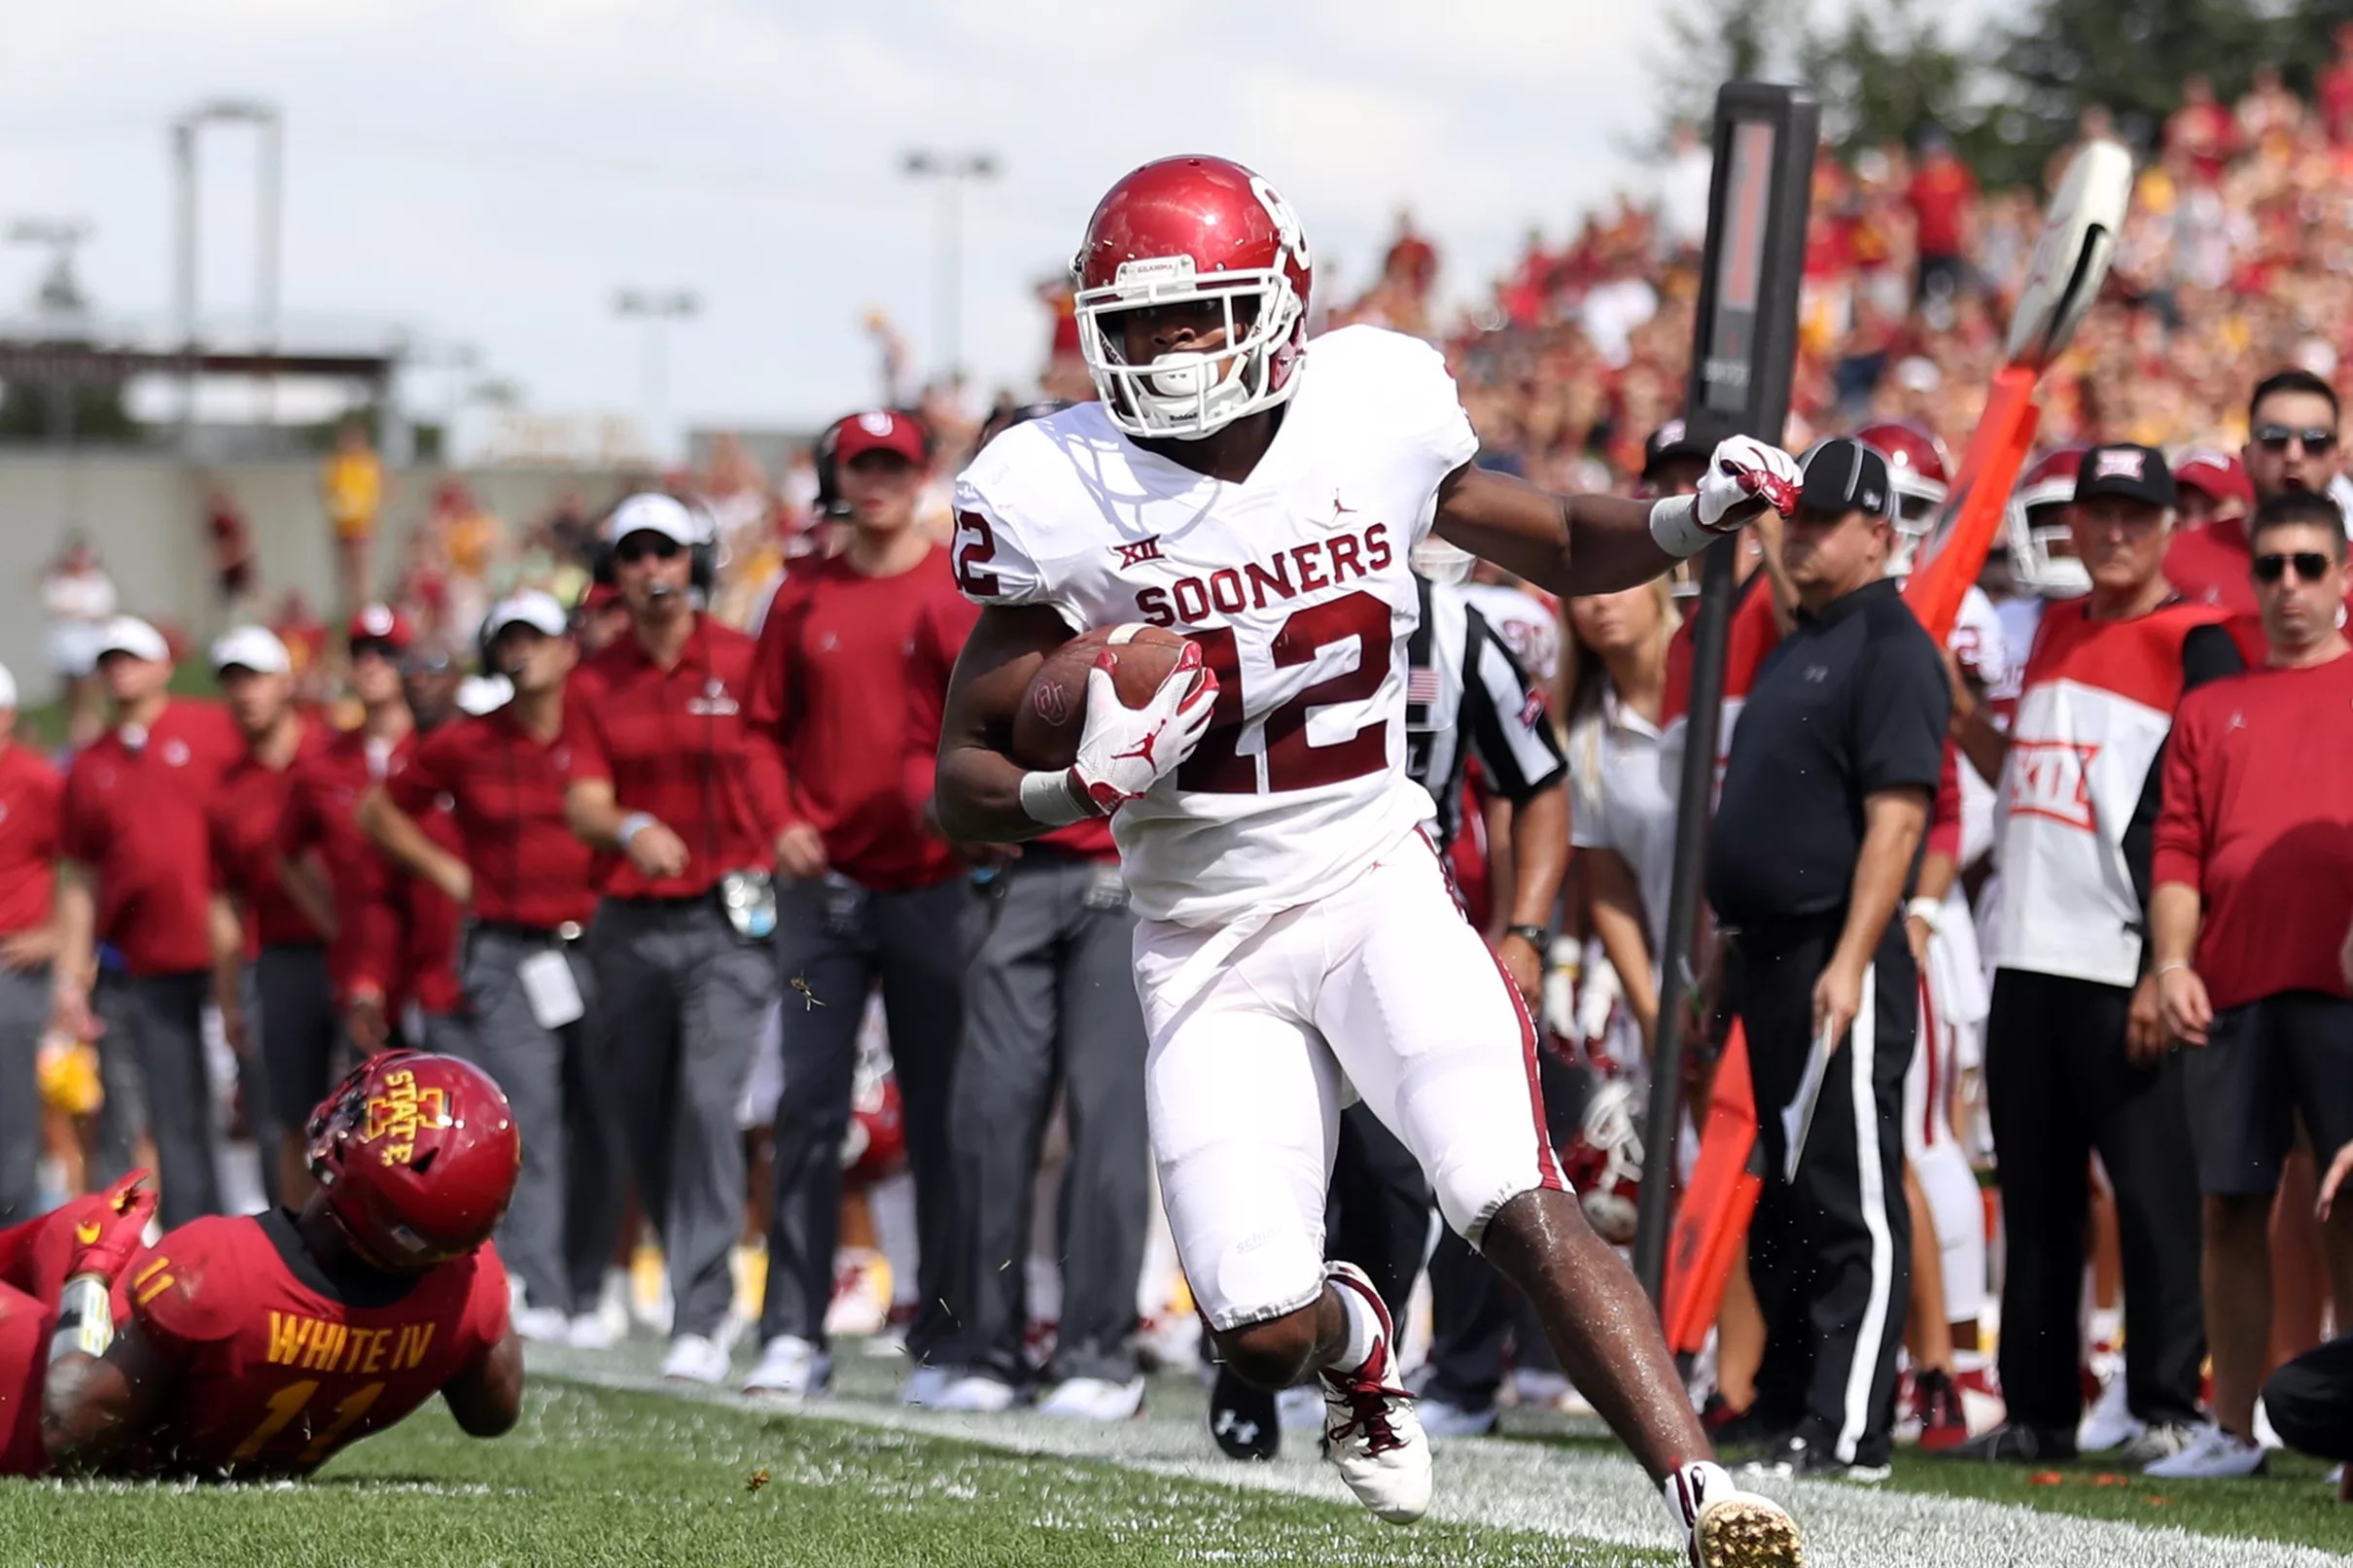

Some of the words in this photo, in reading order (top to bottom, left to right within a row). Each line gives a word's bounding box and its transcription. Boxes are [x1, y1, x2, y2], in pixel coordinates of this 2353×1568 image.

[1136, 522, 1393, 627] SOONERS
[1176, 589, 1393, 794] 12
[382, 1069, 417, 1167] STATE
[267, 1310, 393, 1375] WHITE
[390, 1321, 438, 1371] IV
[228, 1379, 386, 1463] 11
